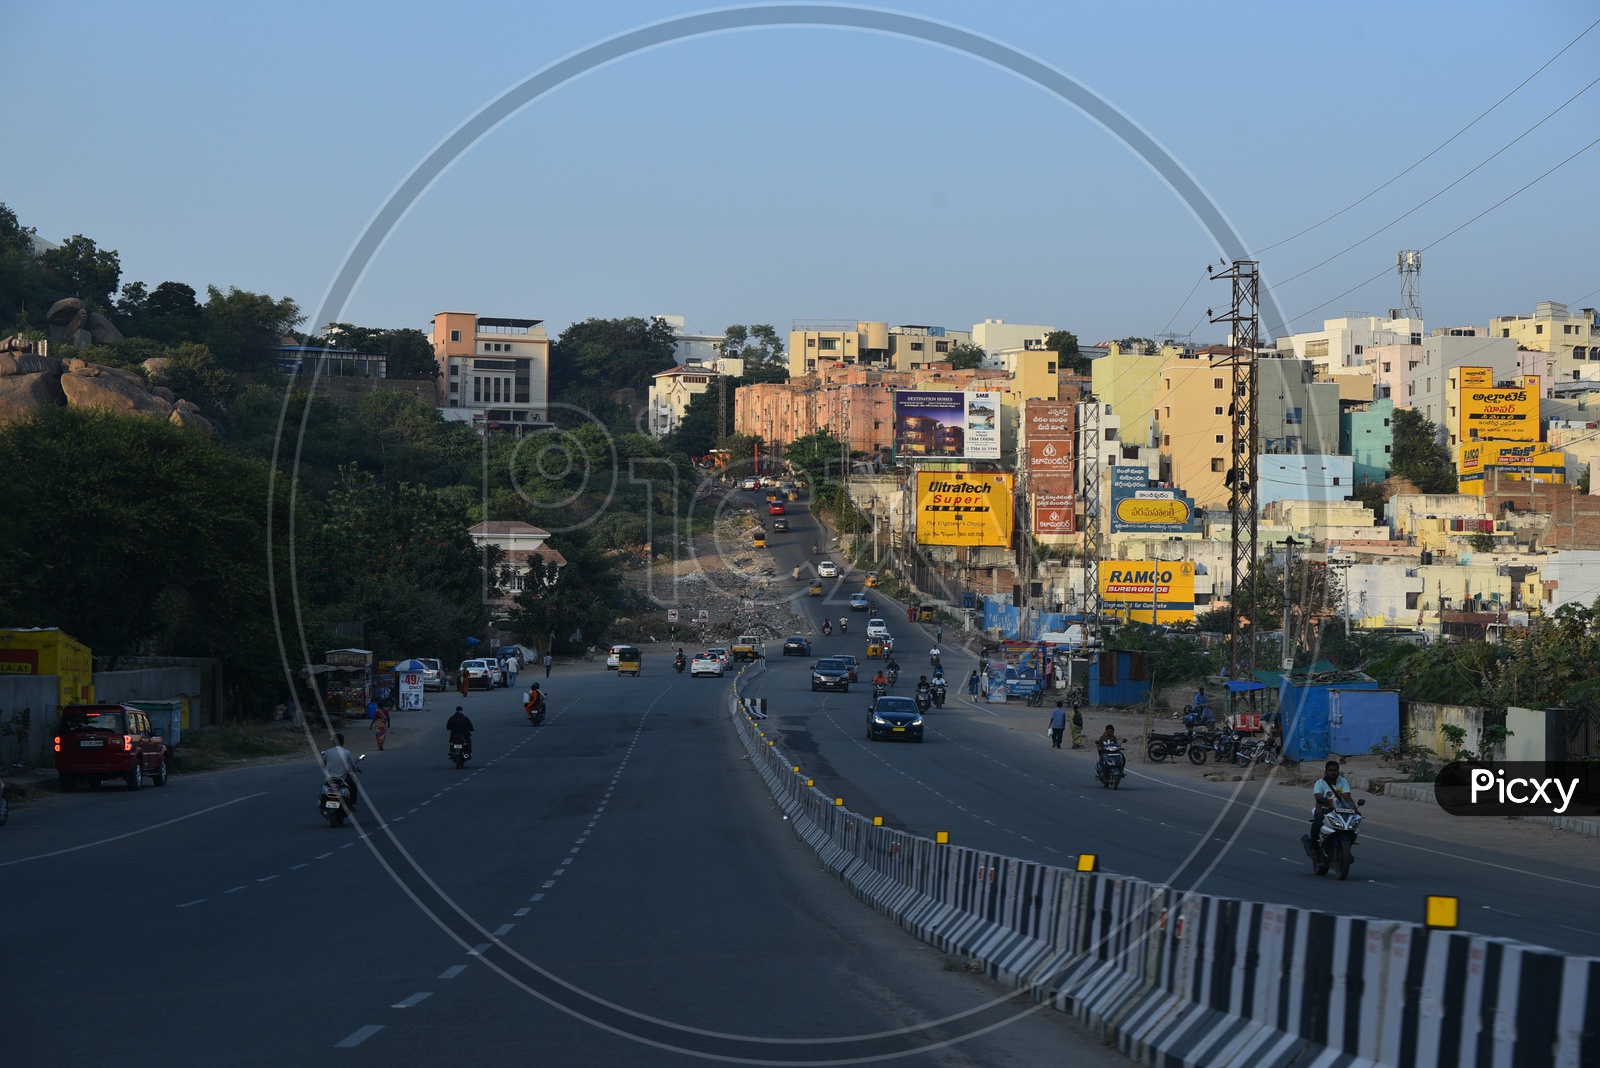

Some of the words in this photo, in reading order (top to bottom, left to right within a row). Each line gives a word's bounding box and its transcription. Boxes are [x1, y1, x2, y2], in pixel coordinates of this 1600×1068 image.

[929, 482, 991, 493] UltraTech
[933, 494, 980, 506] Super
[1110, 571, 1172, 583] RAMCO
